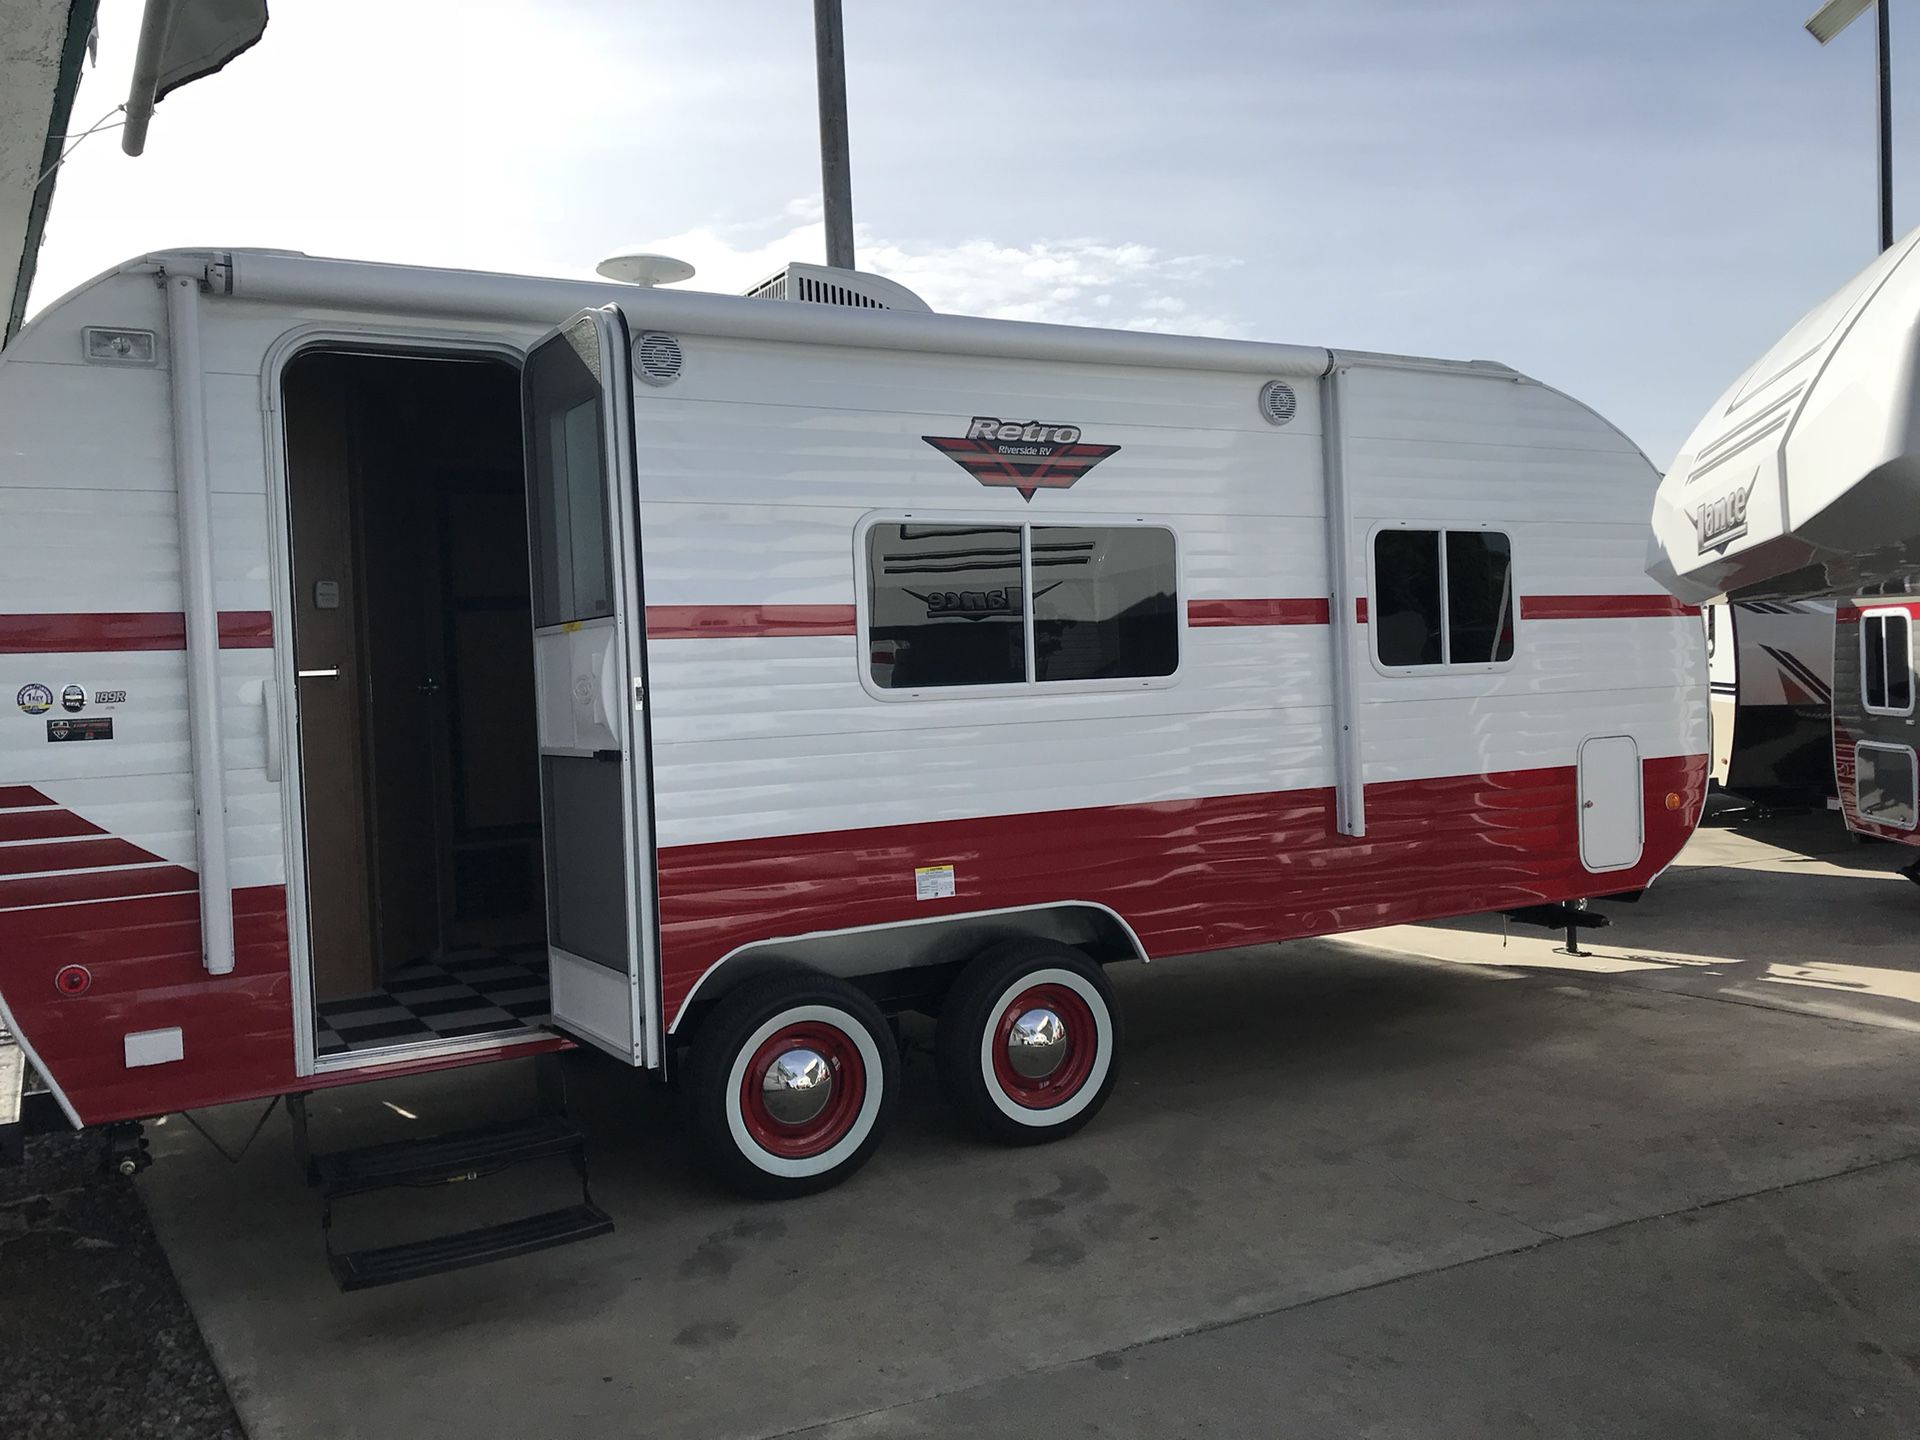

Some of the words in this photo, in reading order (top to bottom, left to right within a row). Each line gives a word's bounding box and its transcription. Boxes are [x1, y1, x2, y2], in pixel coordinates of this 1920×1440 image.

[967, 417, 1081, 444] Retro
[998, 445, 1037, 455] Riverside
[1039, 447, 1052, 456] RV
[1697, 486, 1748, 556] Lance
[95, 691, 126, 703] 189R
